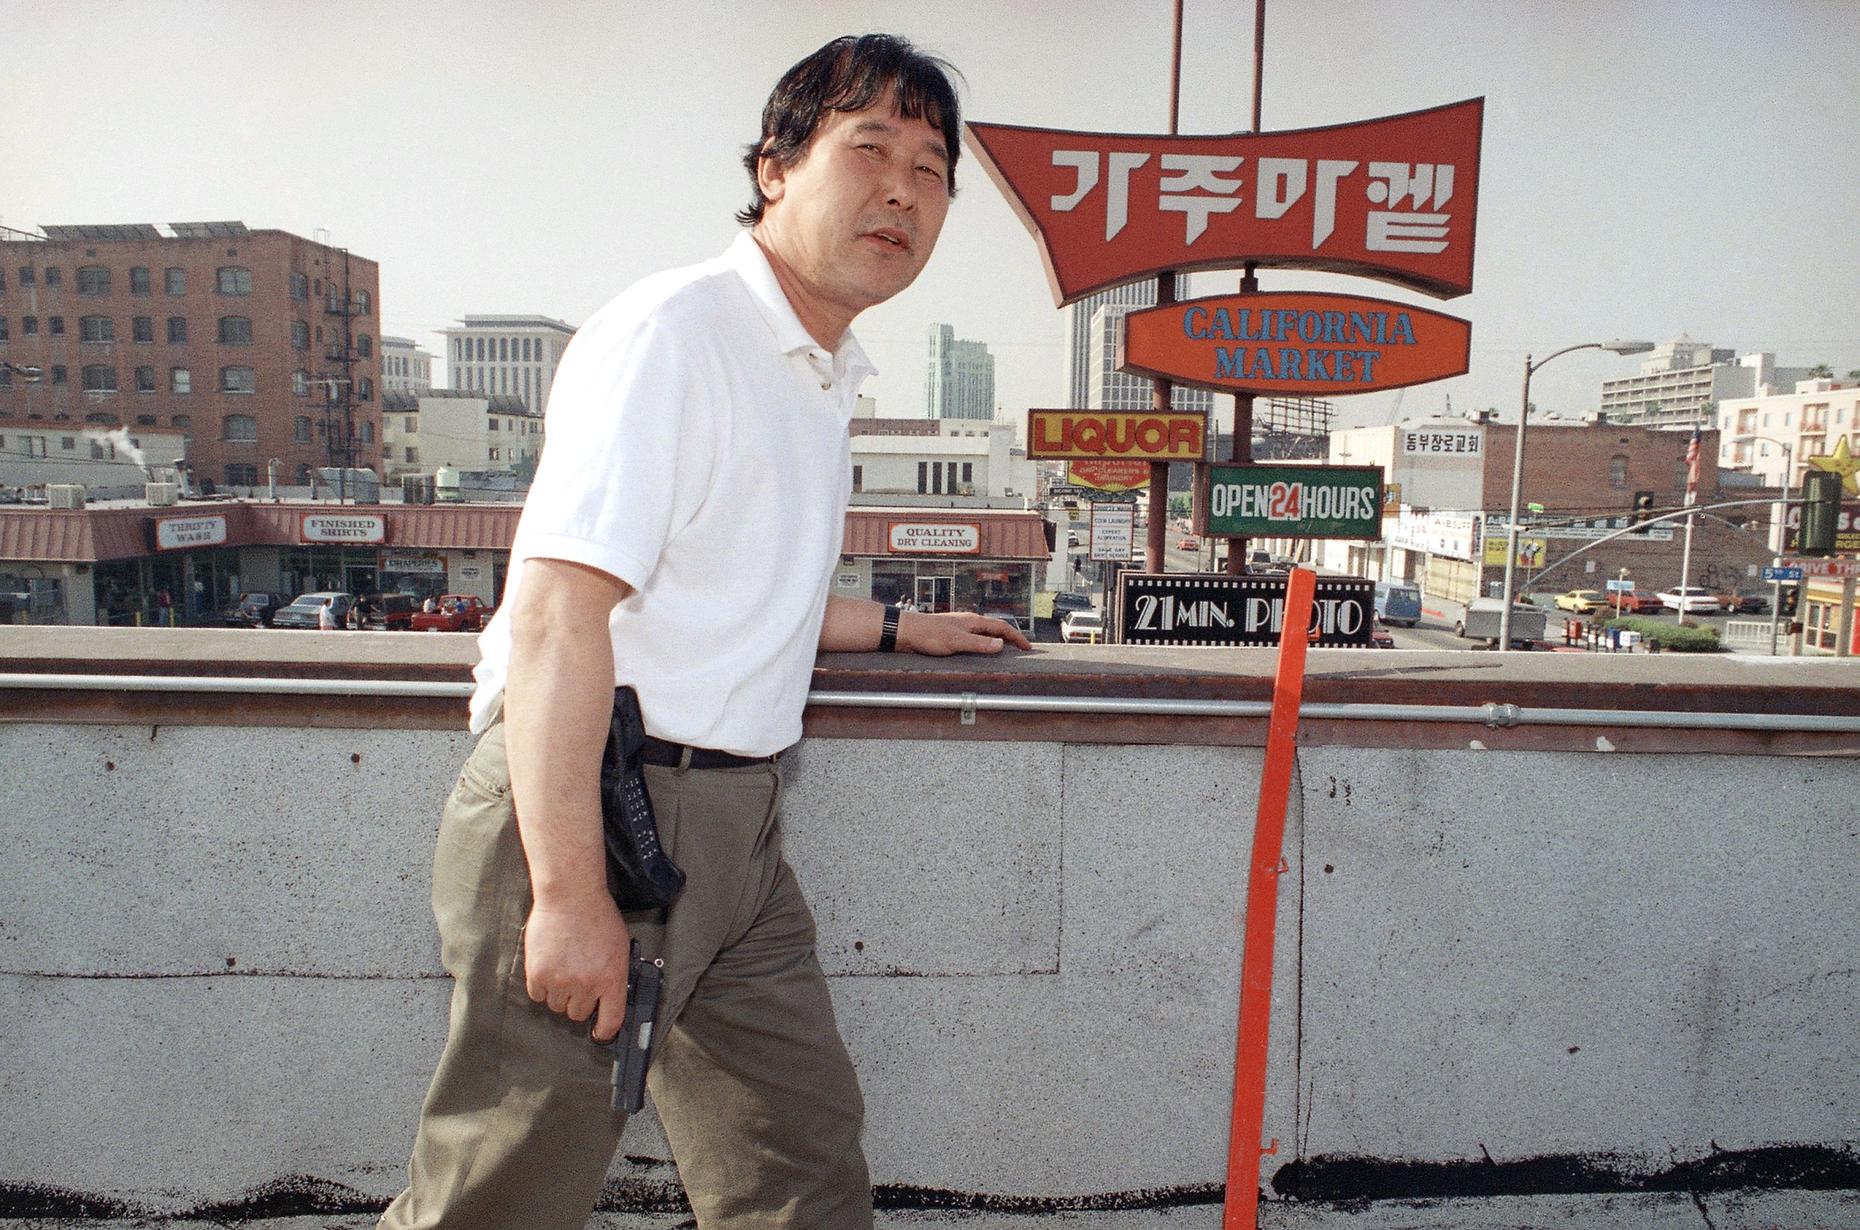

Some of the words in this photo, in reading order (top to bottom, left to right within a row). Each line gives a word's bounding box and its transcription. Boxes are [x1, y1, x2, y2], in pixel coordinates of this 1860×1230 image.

[1182, 306, 1418, 346] CALIFORNIA
[1214, 345, 1383, 383] MARKET
[1034, 417, 1202, 455] LIQUOR
[1406, 433, 1479, 453] 동부장로교회
[1212, 483, 1269, 518] OPEN
[1268, 481, 1304, 521] 24
[1302, 485, 1375, 520] HOURS
[311, 519, 376, 529] FINISHED
[320, 528, 368, 538] SHIRTS
[906, 528, 966, 537] QUALITY
[176, 532, 212, 543] WASH
[897, 538, 918, 547] DRY
[920, 539, 972, 548] CLEANING
[1134, 595, 1175, 631] 21
[1176, 600, 1236, 629] MIN.
